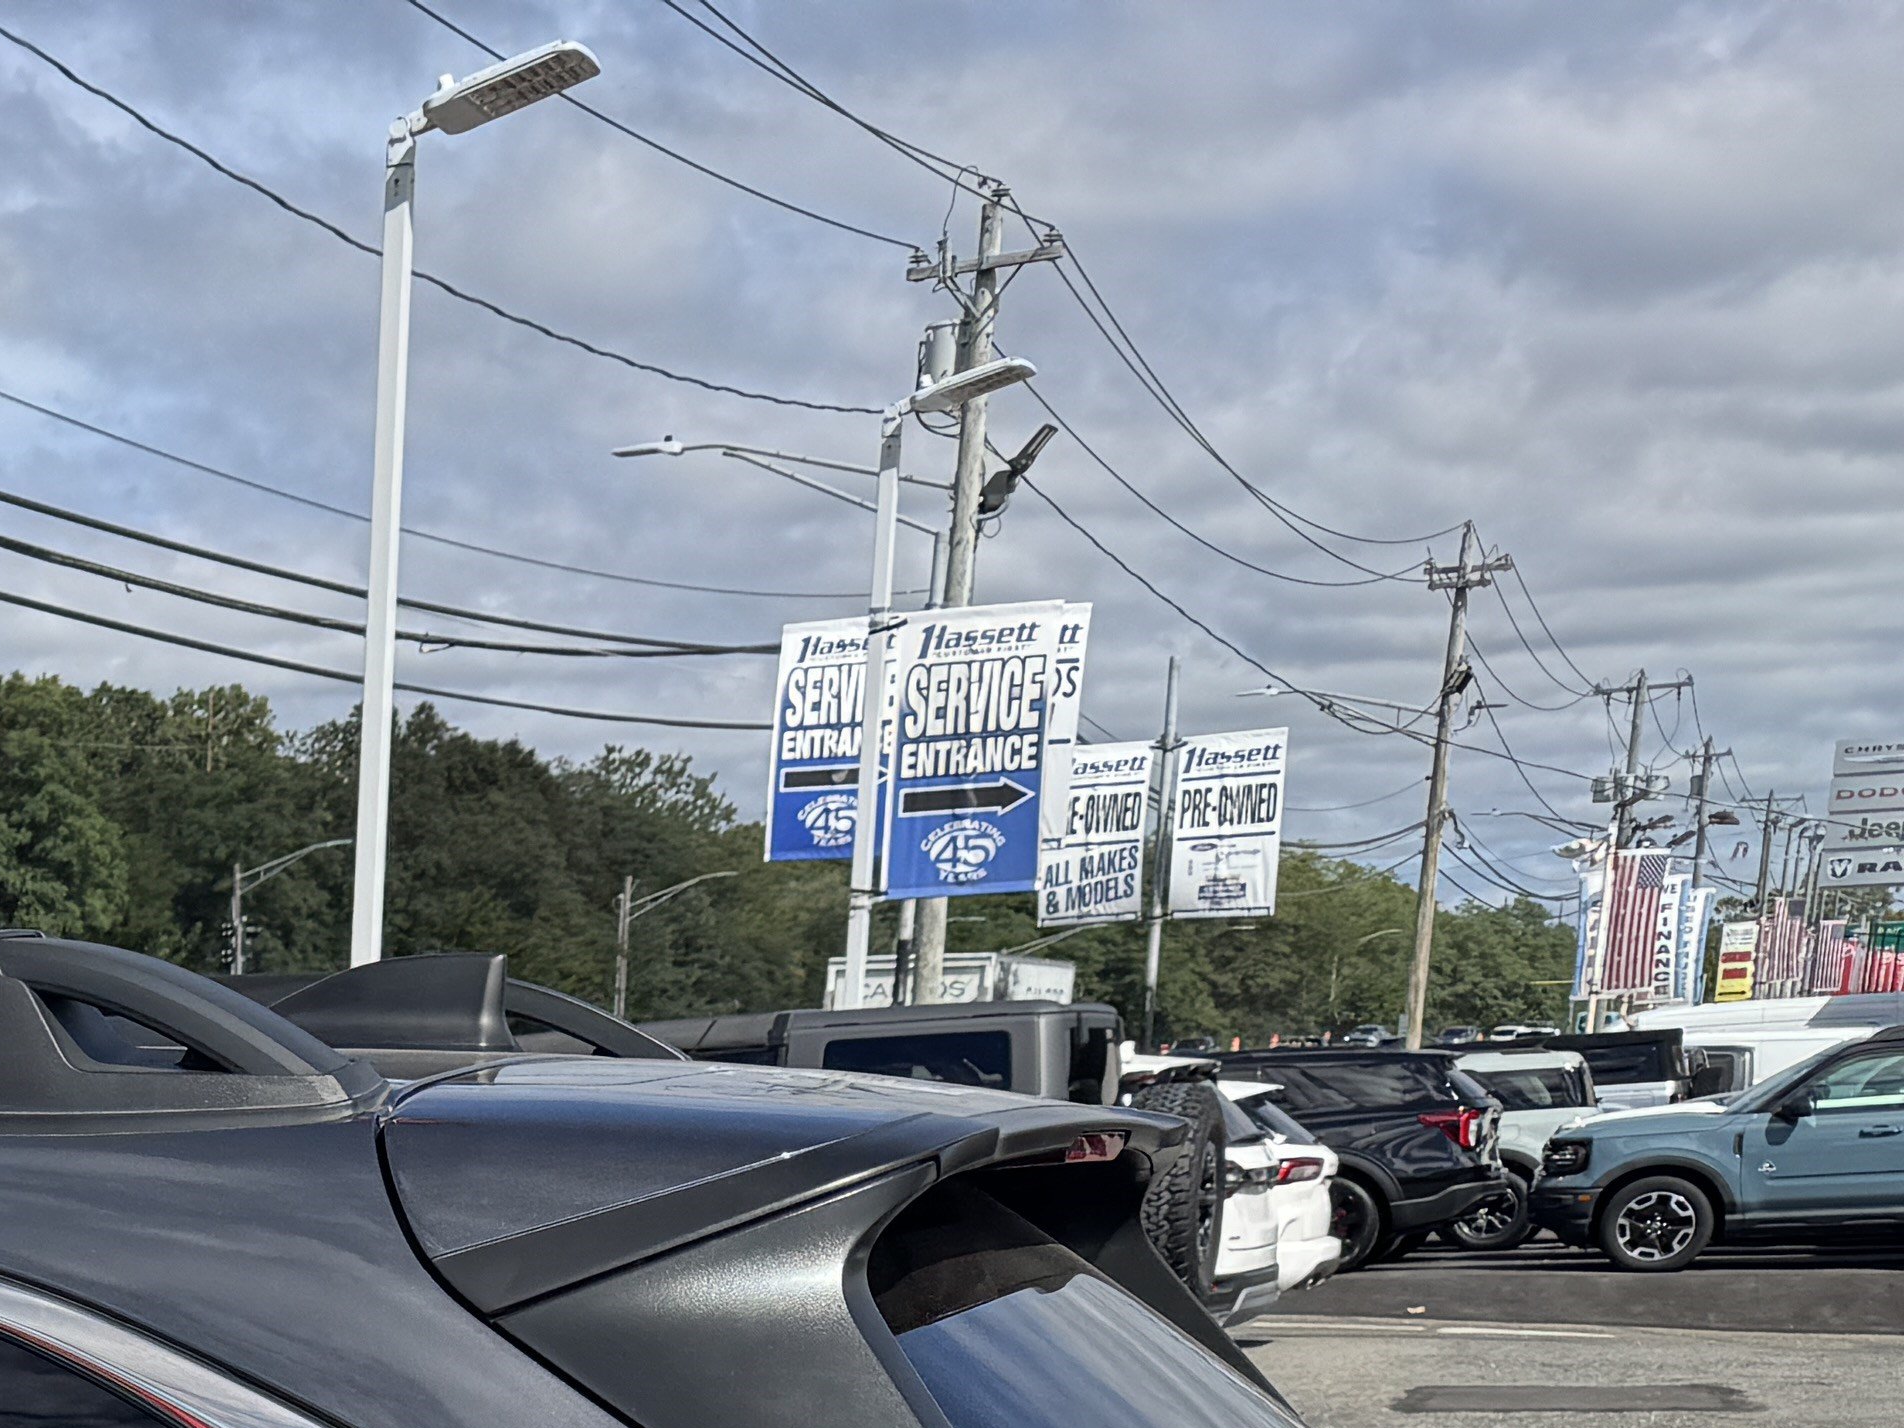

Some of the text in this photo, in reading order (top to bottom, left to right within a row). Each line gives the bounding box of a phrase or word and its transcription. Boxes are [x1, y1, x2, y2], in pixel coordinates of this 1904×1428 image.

[917, 622, 1041, 660] Hassett
[904, 654, 1047, 740] SERVICE
[900, 733, 1040, 780] ENTRANCE
[1072, 756, 1148, 776] assett
[1182, 743, 1282, 774] Hassett
[1179, 782, 1278, 829] PRE-OWNED
[1836, 786, 1904, 801] DOD
[809, 806, 856, 834] 45
[1068, 792, 1143, 835] E-OWNED
[920, 818, 1006, 852] CELEBRATING
[935, 833, 991, 869] 45
[1043, 845, 1139, 889] ALL MAKES
[1856, 860, 1904, 874] RA
[1046, 873, 1135, 915] & MODELS
